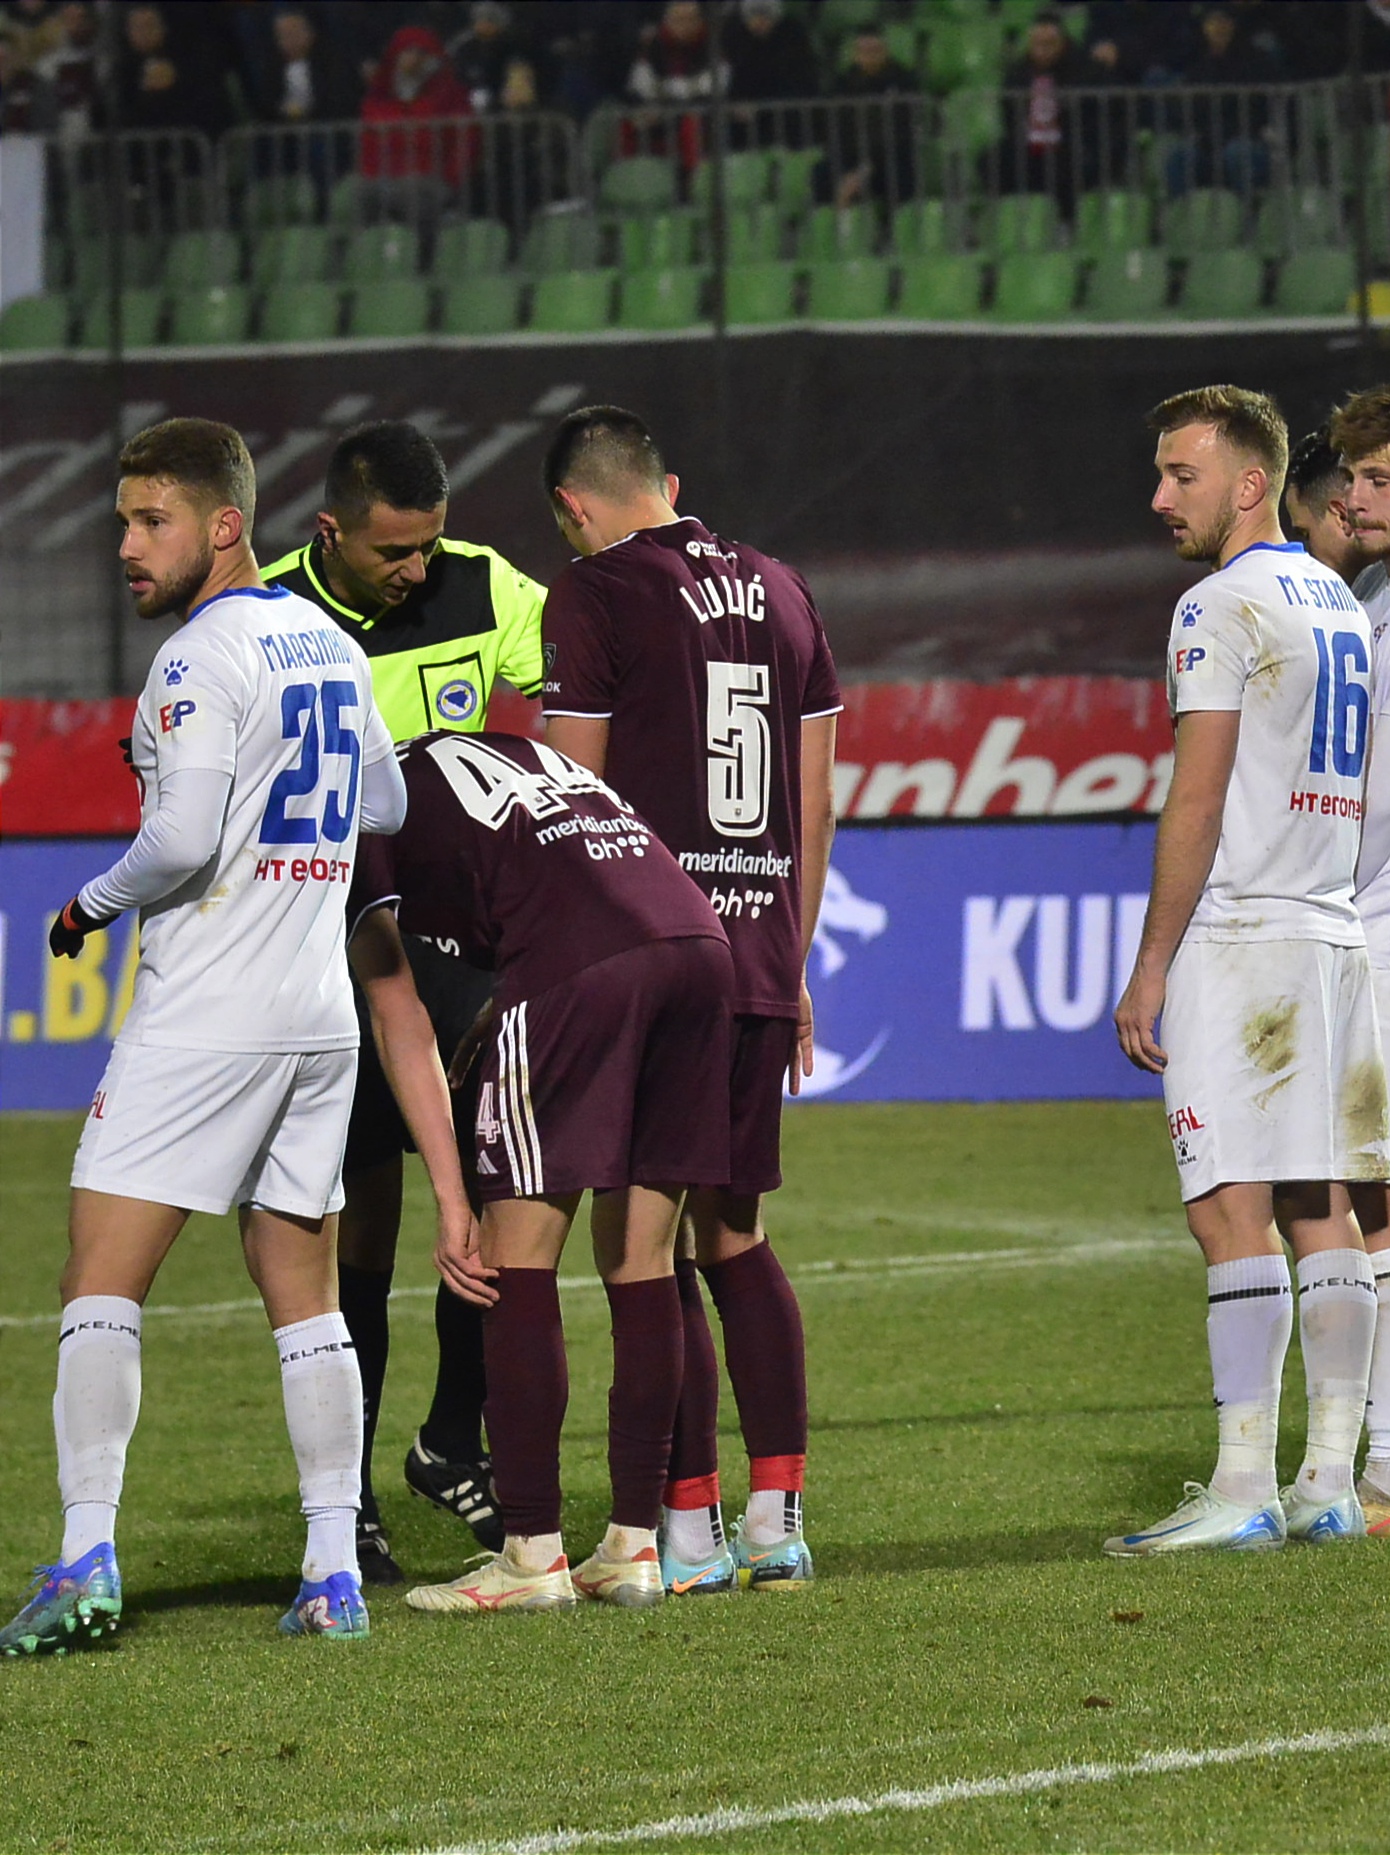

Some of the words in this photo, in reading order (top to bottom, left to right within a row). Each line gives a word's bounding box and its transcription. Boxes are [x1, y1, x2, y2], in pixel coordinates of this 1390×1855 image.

[679, 574, 766, 624] LULIĆ
[1176, 646, 1206, 675] EP
[159, 700, 197, 734] EP
[1308, 627, 1370, 779] 16
[258, 680, 361, 844] 25
[706, 661, 771, 838] 5
[678, 846, 793, 878] meridianbet
[280, 1342, 340, 1364] KELME
